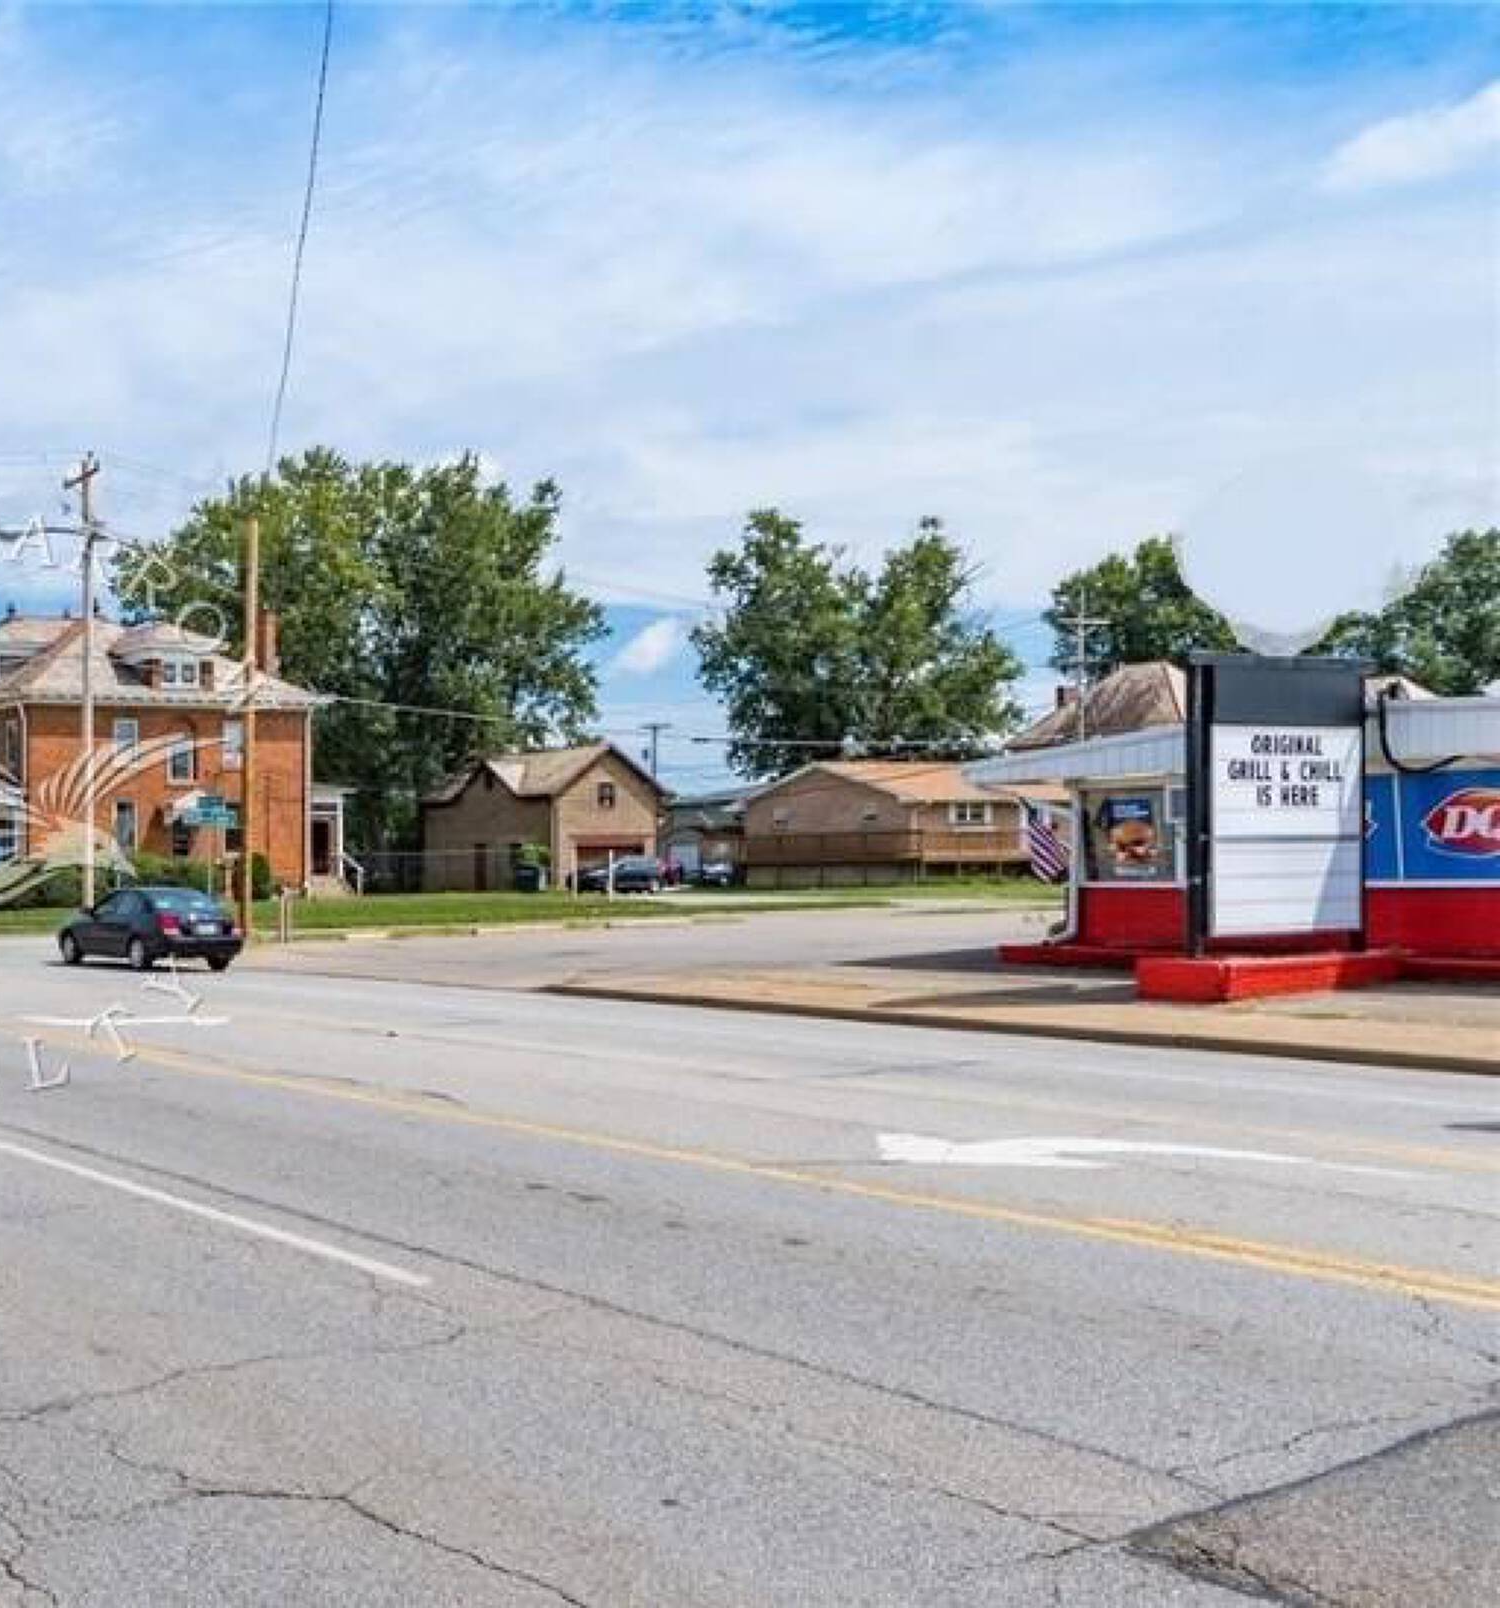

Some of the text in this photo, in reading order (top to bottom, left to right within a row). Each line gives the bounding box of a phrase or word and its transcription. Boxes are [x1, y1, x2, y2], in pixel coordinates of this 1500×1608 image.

[1251, 734, 1323, 756] ORIGINAL
[1228, 759, 1343, 782] GRILL & CHILL
[1257, 785, 1320, 806] IS HERE
